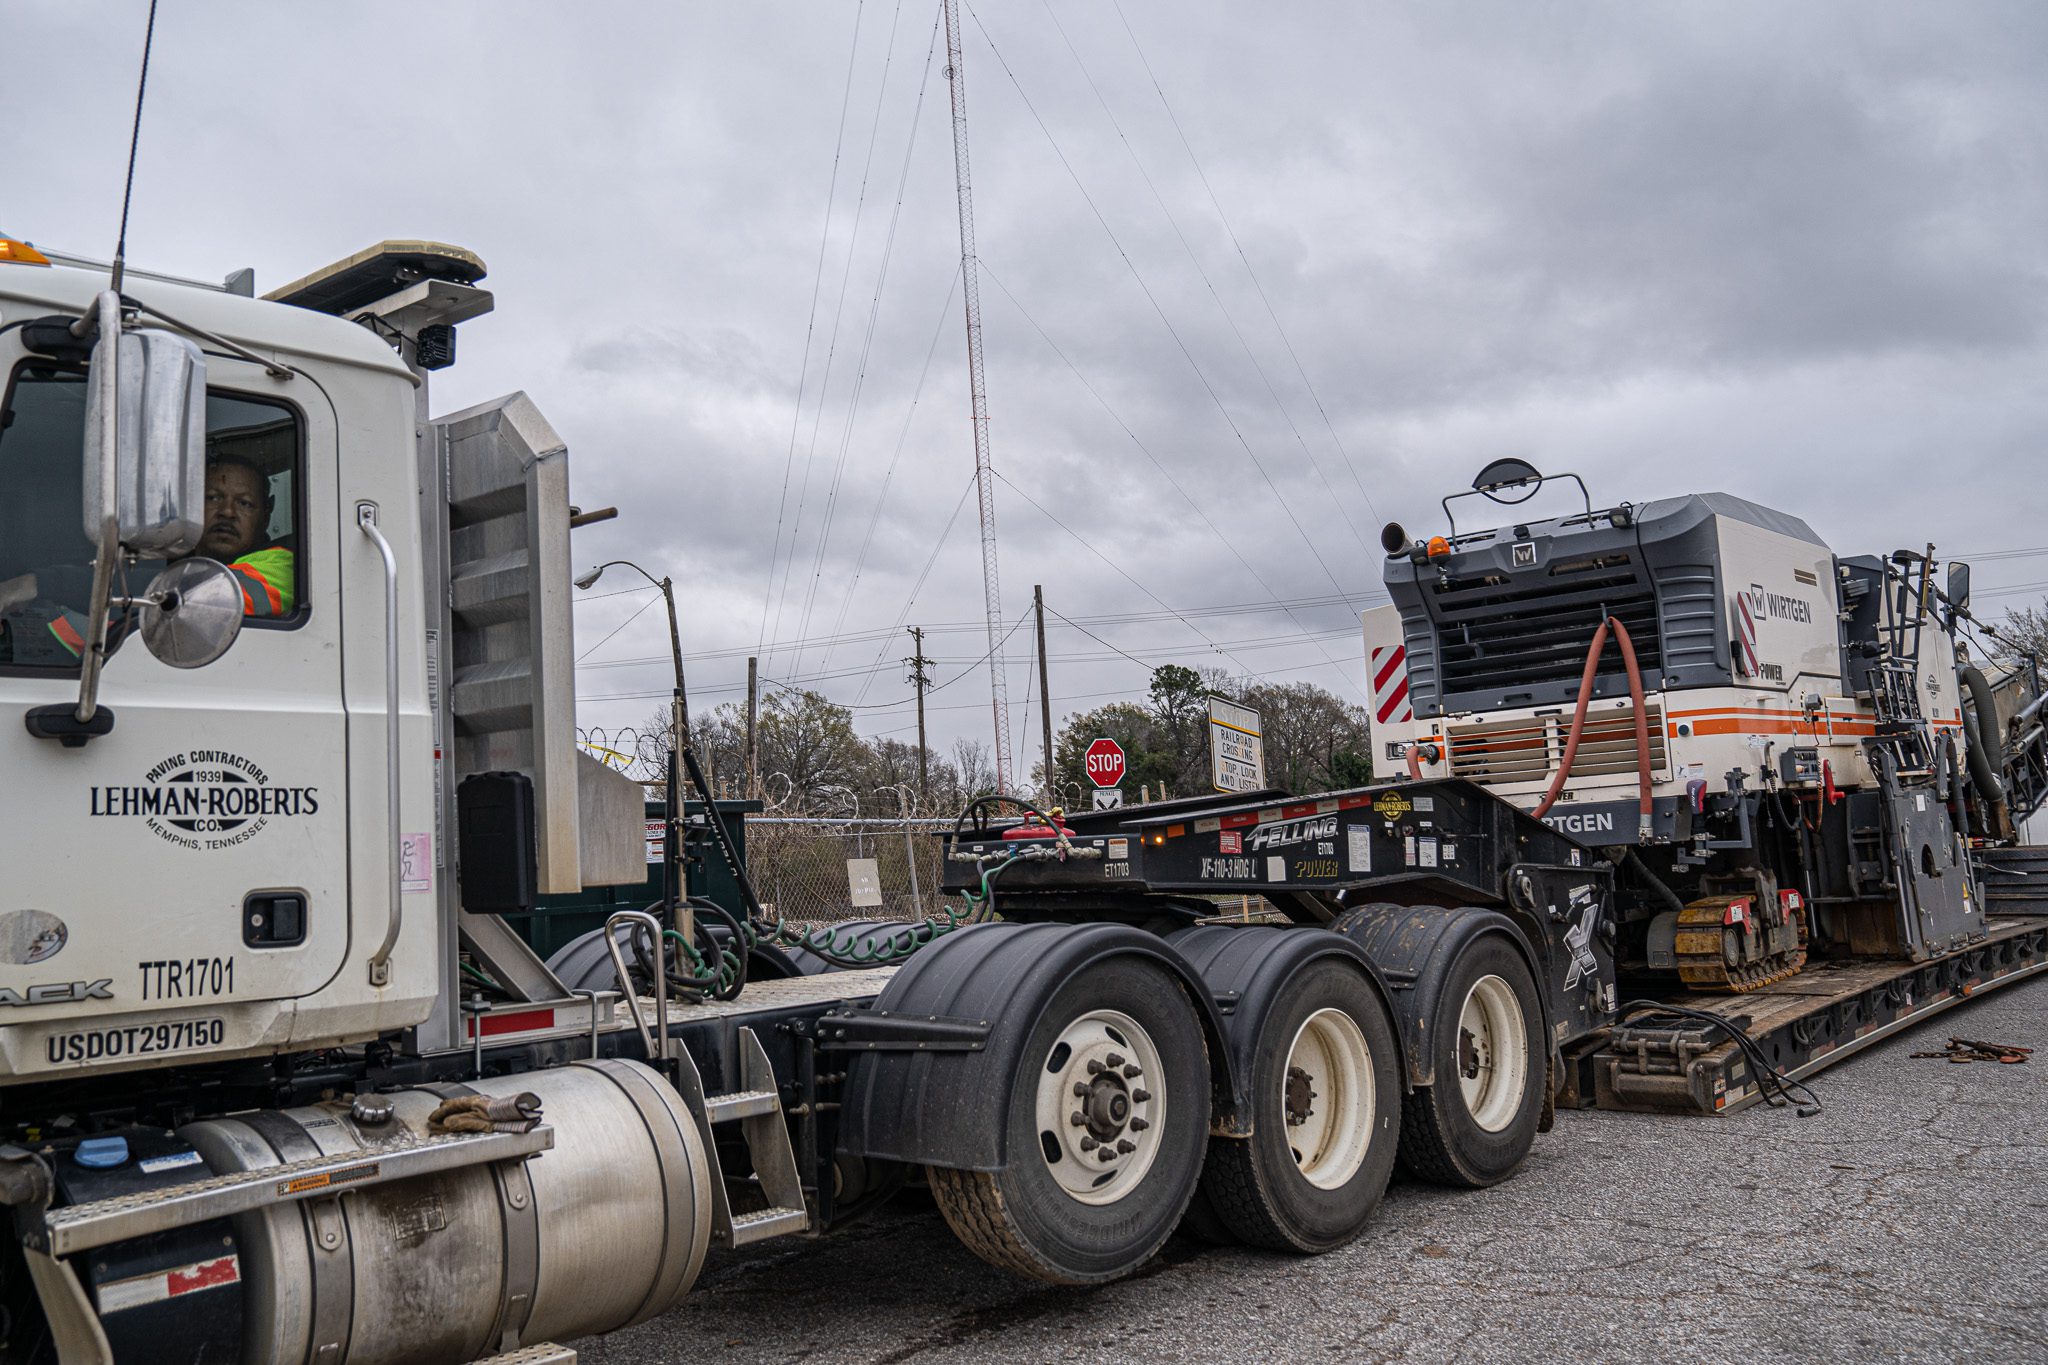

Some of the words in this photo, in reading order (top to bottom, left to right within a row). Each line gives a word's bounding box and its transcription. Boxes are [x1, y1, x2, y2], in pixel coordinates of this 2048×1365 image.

[1767, 593, 1812, 624] WIRTGEN
[1759, 663, 1783, 681] POWER
[1220, 729, 1253, 749] RAILROAD
[1222, 742, 1253, 761] CROSSING
[146, 754, 186, 784] PAVING
[190, 750, 269, 785] CONTRACTORS
[1089, 754, 1122, 772] STOP
[195, 770, 221, 783] 1939
[1220, 774, 1235, 787] AND
[1239, 779, 1260, 791] LISTEN
[1240, 765, 1258, 781] LOOK
[90, 786, 319, 816] LEHMAN-ROBERTS
[146, 817, 202, 851] MEMPHIS,
[205, 816, 268, 850] TENNESSEE
[1104, 863, 1130, 878] ET1703
[1201, 858, 1233, 878] XF-110-3
[1233, 858, 1249, 878] HDG
[1251, 858, 1257, 878] L
[1294, 860, 1338, 878] POWER
[139, 956, 234, 1000] TTR1701
[48, 1019, 224, 1063] USDOT297150
